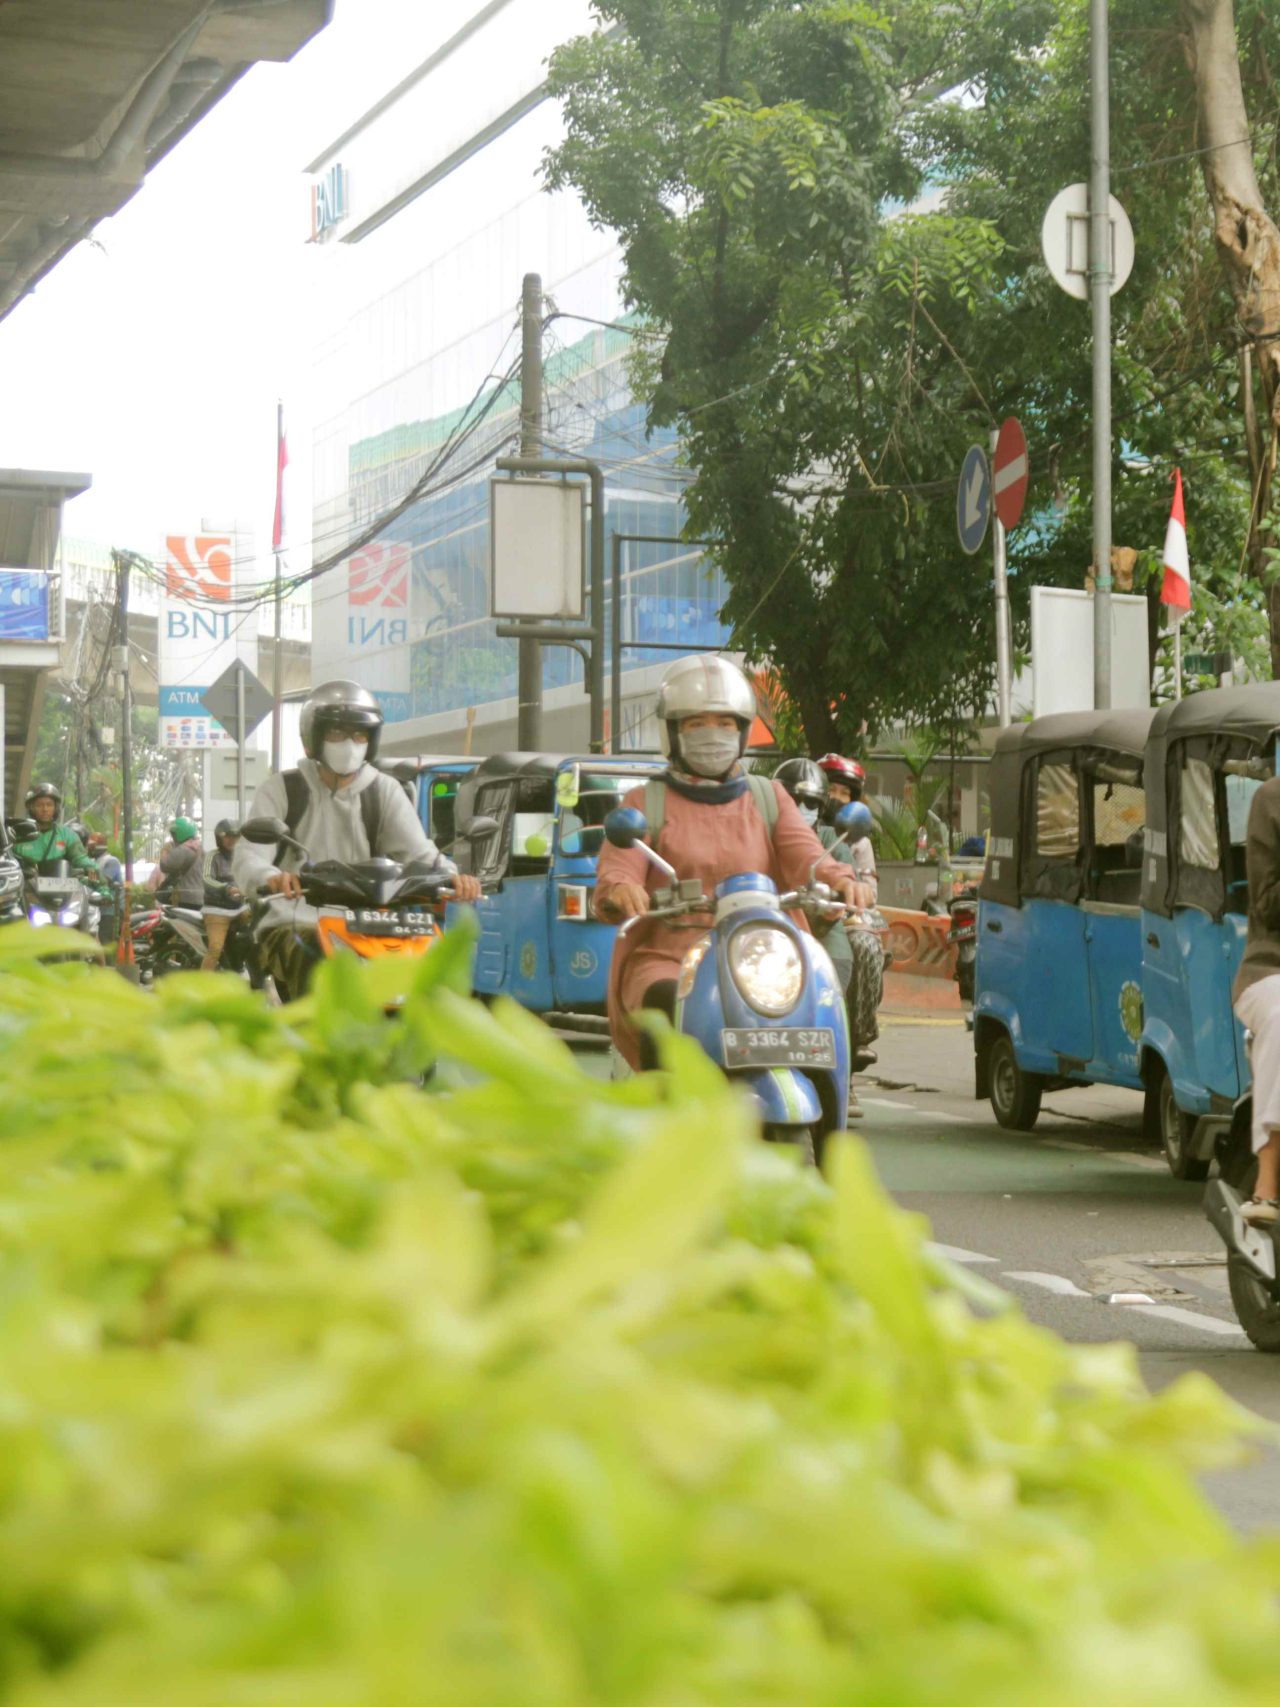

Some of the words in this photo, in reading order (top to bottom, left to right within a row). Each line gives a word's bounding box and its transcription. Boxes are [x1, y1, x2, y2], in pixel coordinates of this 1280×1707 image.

[167, 610, 230, 641] BNI
[168, 692, 200, 704] ATM
[345, 910, 356, 920] B
[362, 911, 399, 922] 6344
[571, 951, 592, 968] JS
[725, 1032, 737, 1046] B
[798, 1031, 830, 1047] SZR
